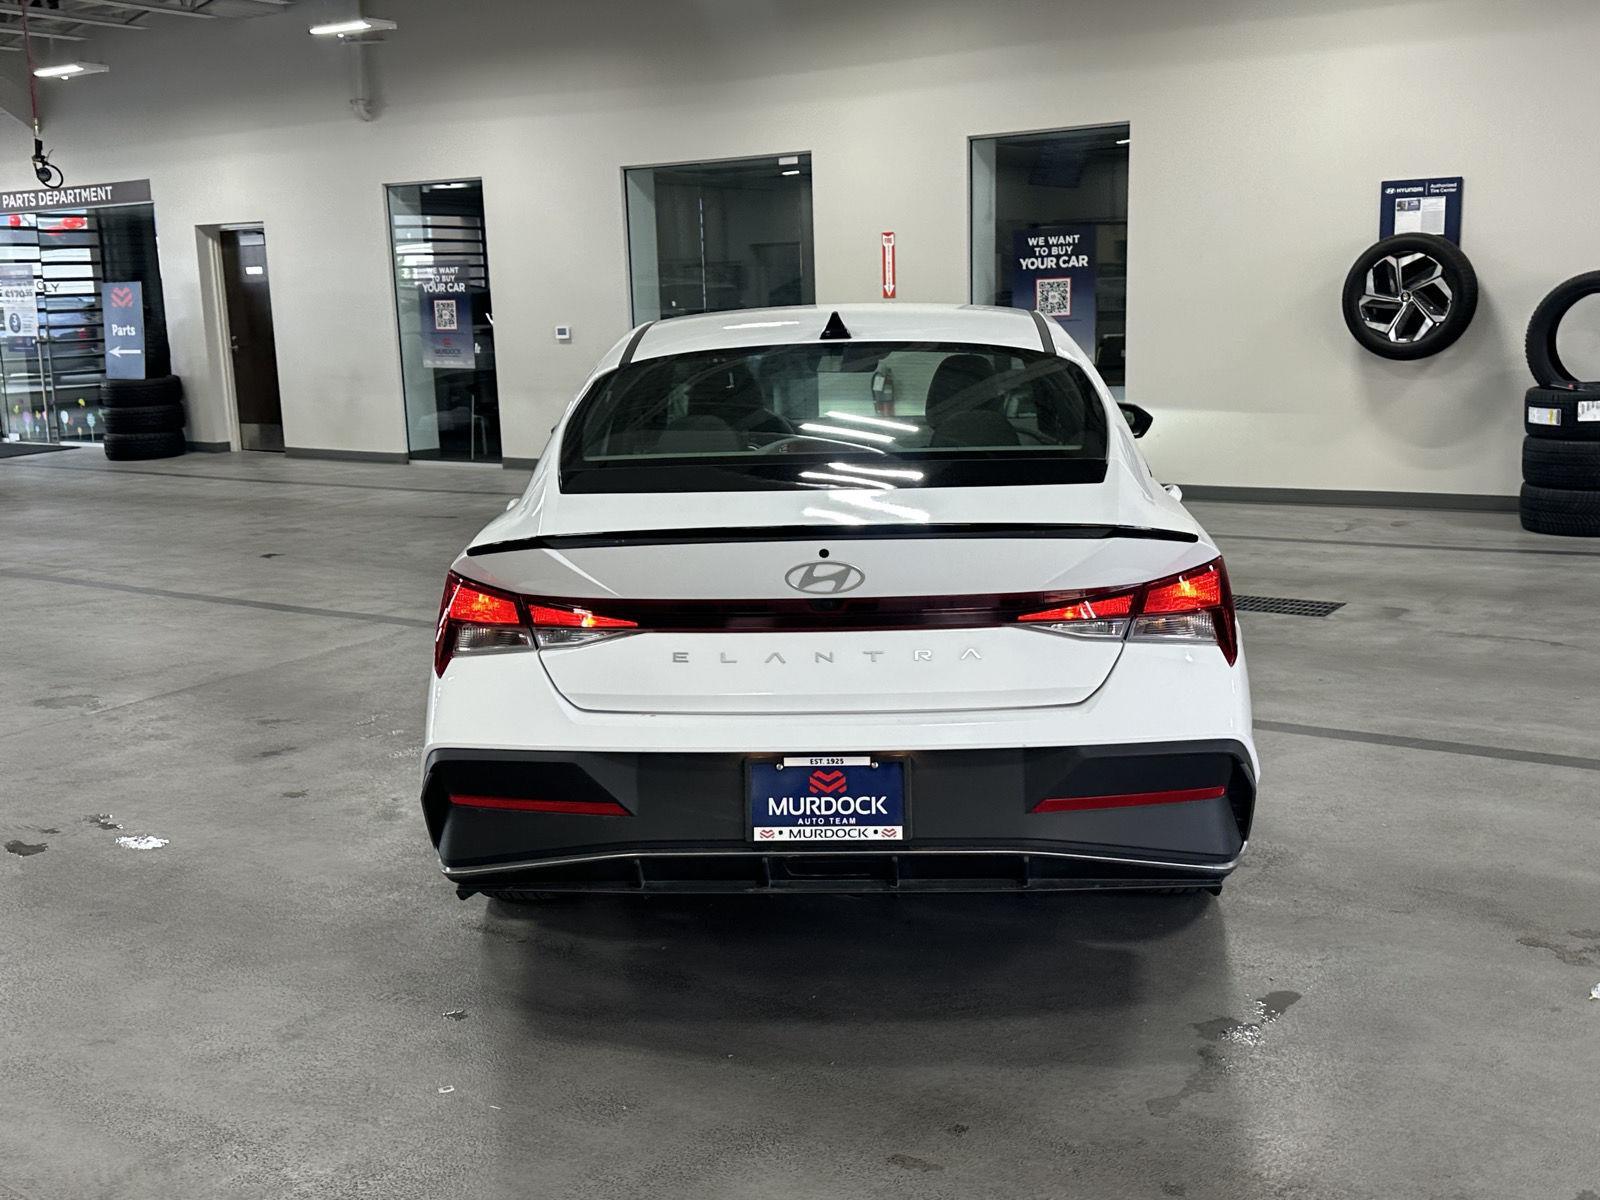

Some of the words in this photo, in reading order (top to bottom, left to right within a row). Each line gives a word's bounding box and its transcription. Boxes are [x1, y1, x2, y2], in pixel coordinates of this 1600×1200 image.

[2, 193, 37, 208] PARTS
[38, 186, 113, 206] DEPARTMENT
[1027, 236, 1046, 246] WE
[1047, 234, 1080, 245] WANT
[1034, 247, 1049, 256] TO
[1051, 245, 1073, 255] BUY
[1019, 257, 1057, 270] YOUR
[1059, 254, 1089, 268] CAR
[438, 266, 459, 274] WANT
[441, 274, 456, 282] BUY
[422, 282, 447, 293] YOUR
[447, 282, 466, 293] CAR
[111, 324, 136, 336] Parts
[672, 647, 983, 664] ELANTRA
[826, 757, 844, 765] 1925
[768, 796, 888, 816] MURDOCK
[797, 817, 825, 825] AUTO
[829, 817, 856, 825] TEAM
[788, 828, 869, 839] MURDOCK
